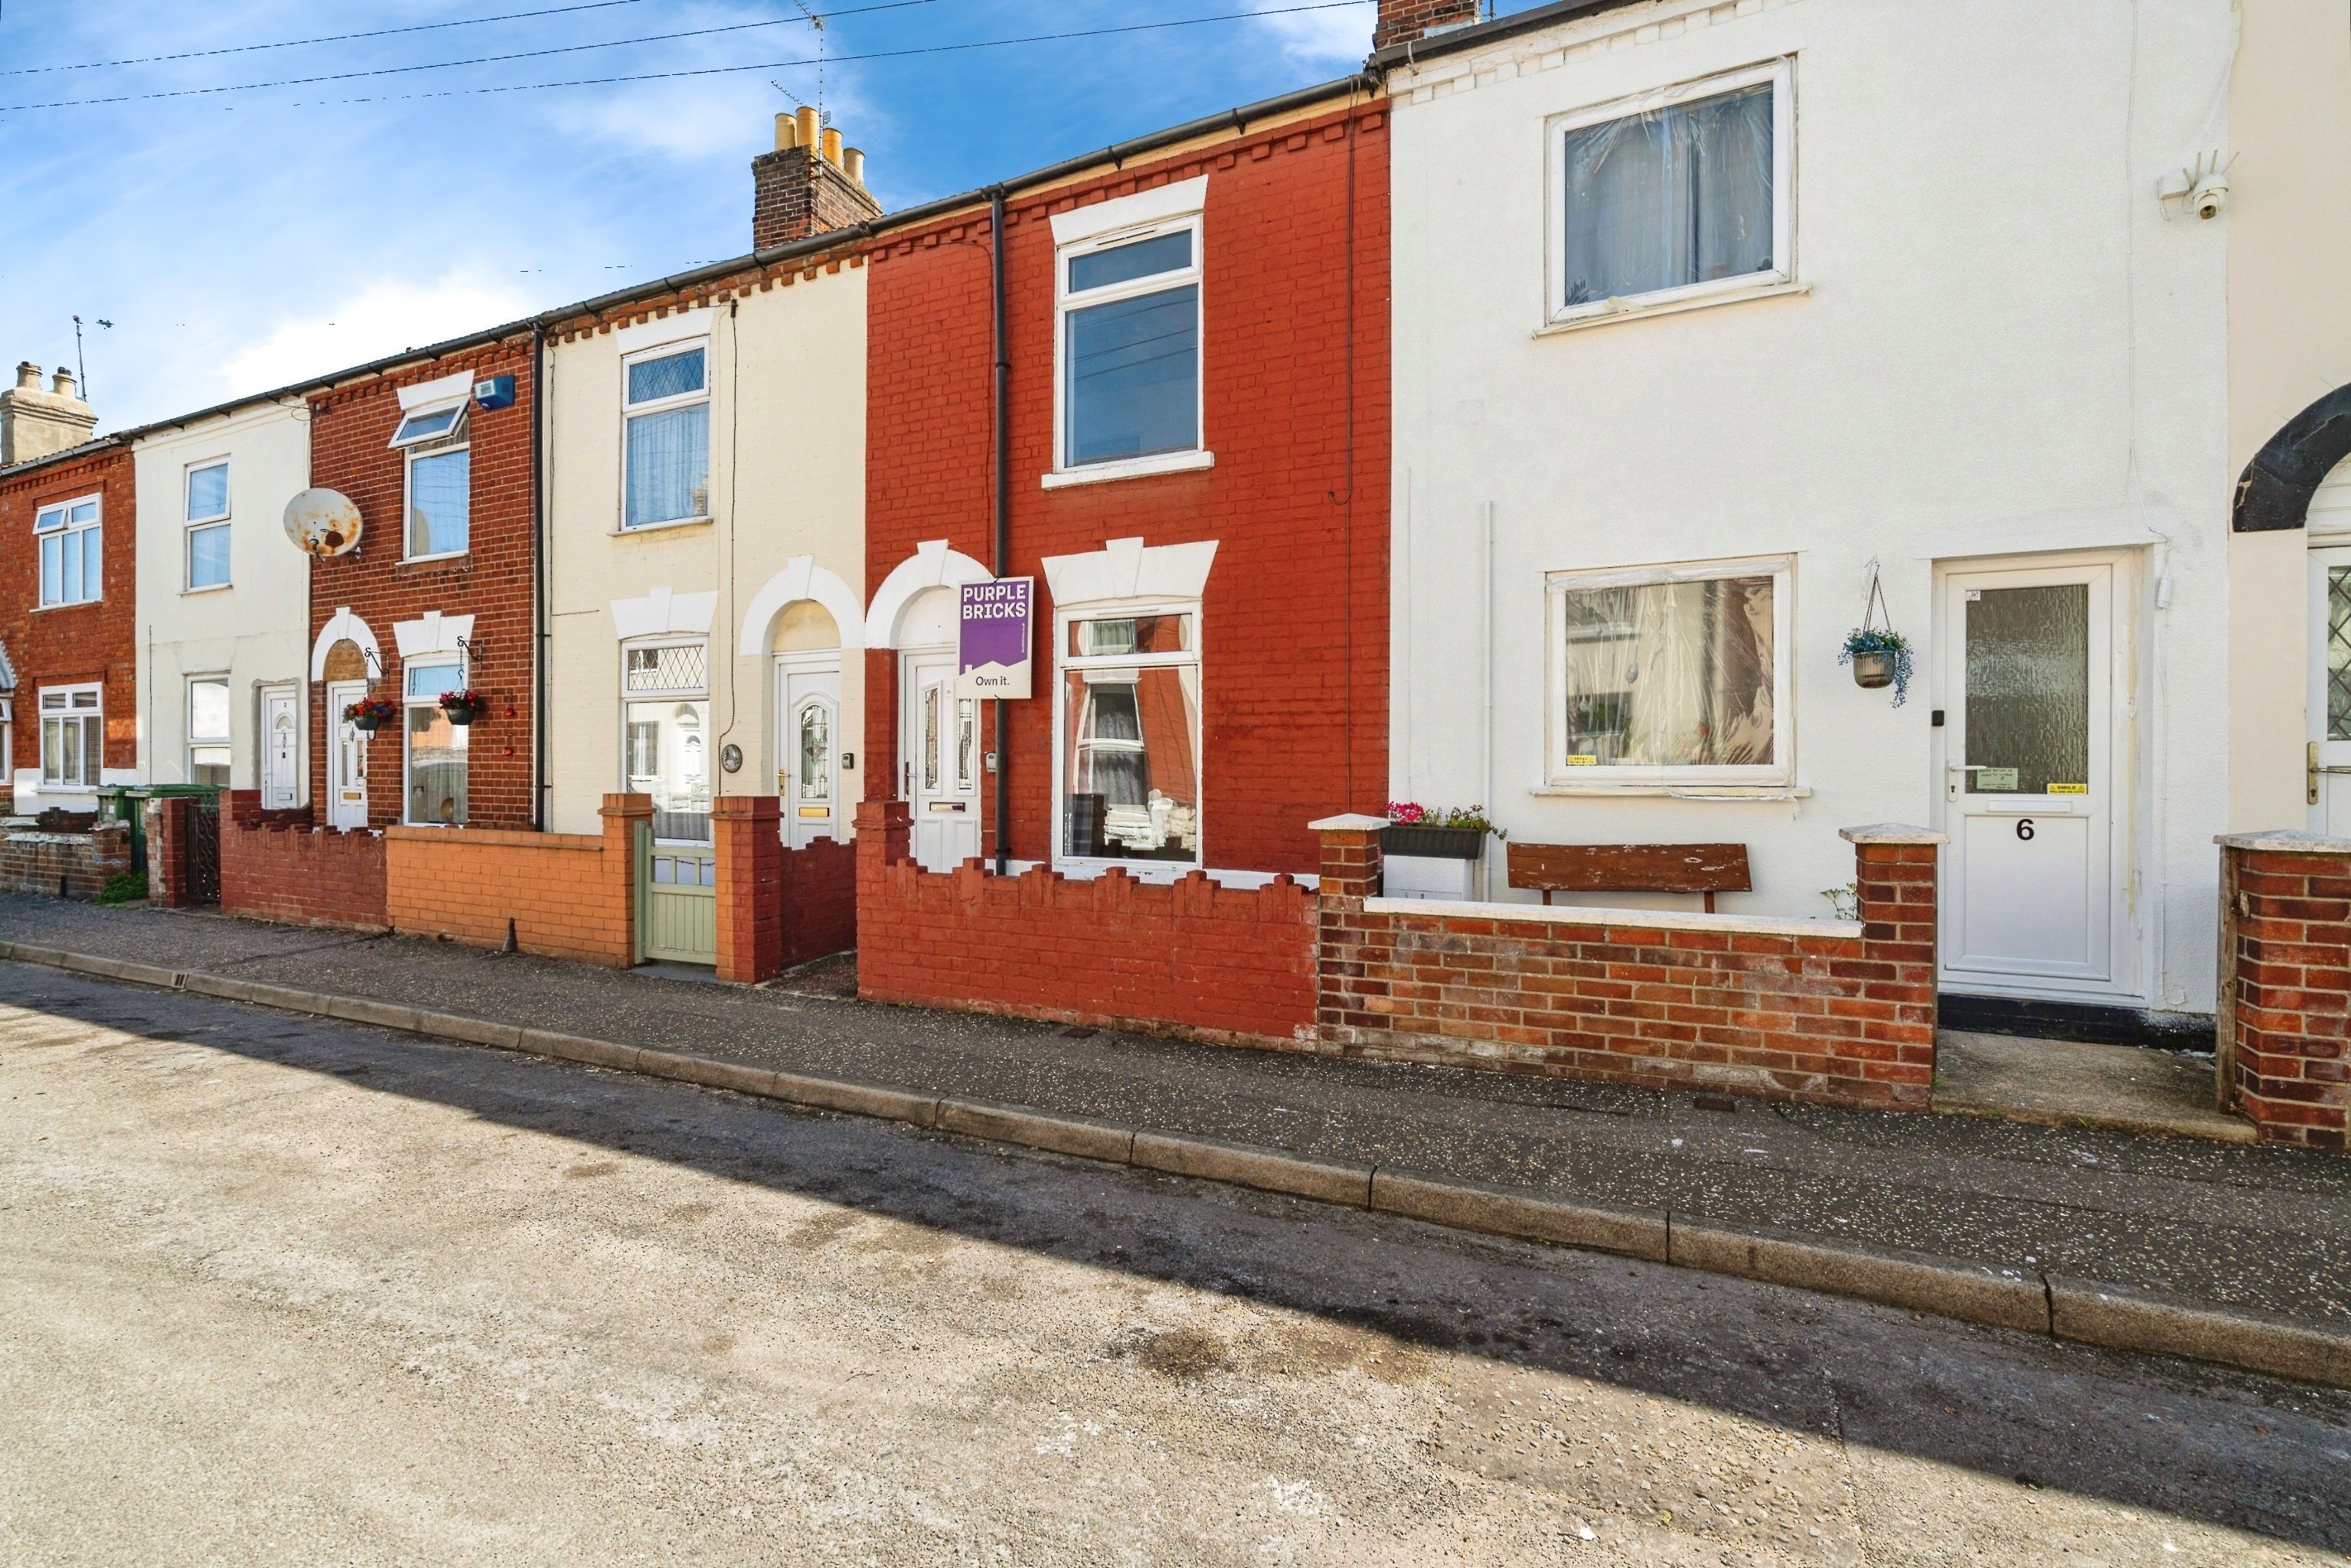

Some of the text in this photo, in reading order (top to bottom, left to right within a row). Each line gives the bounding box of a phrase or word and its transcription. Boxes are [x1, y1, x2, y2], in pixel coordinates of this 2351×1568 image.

[963, 584, 1026, 602] PURPLE
[963, 602, 1026, 619] BRICKS
[975, 675, 1010, 686] Own it.
[2016, 818, 2034, 841] 6
